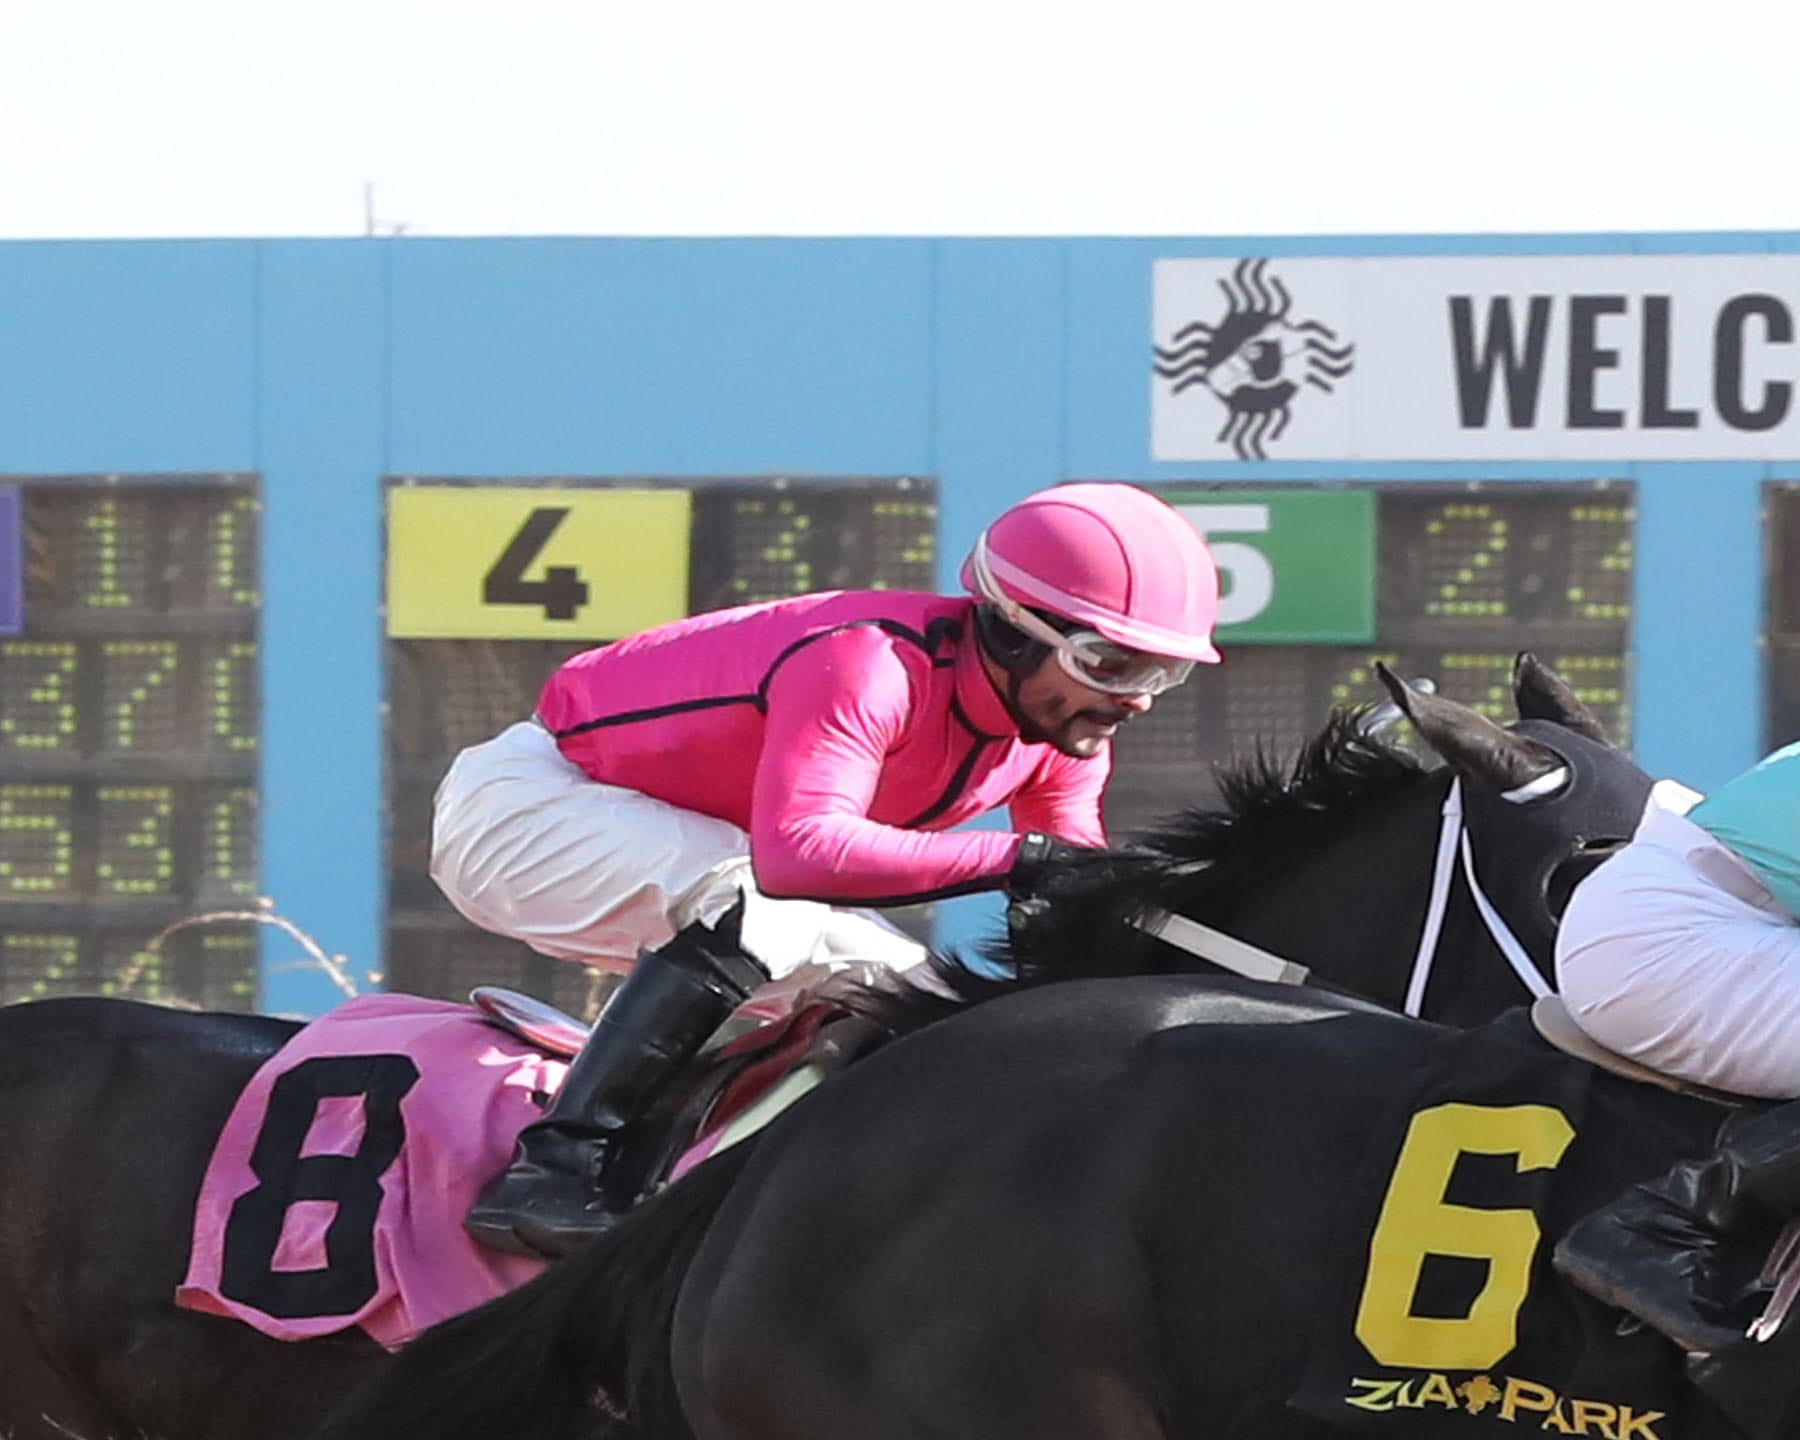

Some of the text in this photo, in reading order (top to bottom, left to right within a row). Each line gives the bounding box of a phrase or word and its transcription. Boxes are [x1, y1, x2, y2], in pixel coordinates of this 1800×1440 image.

[482, 506, 589, 621] 4
[1187, 504, 1274, 625] 5
[218, 1052, 423, 1320] 8
[1354, 1102, 1577, 1371] 6
[1345, 1373, 1458, 1411] ZIA
